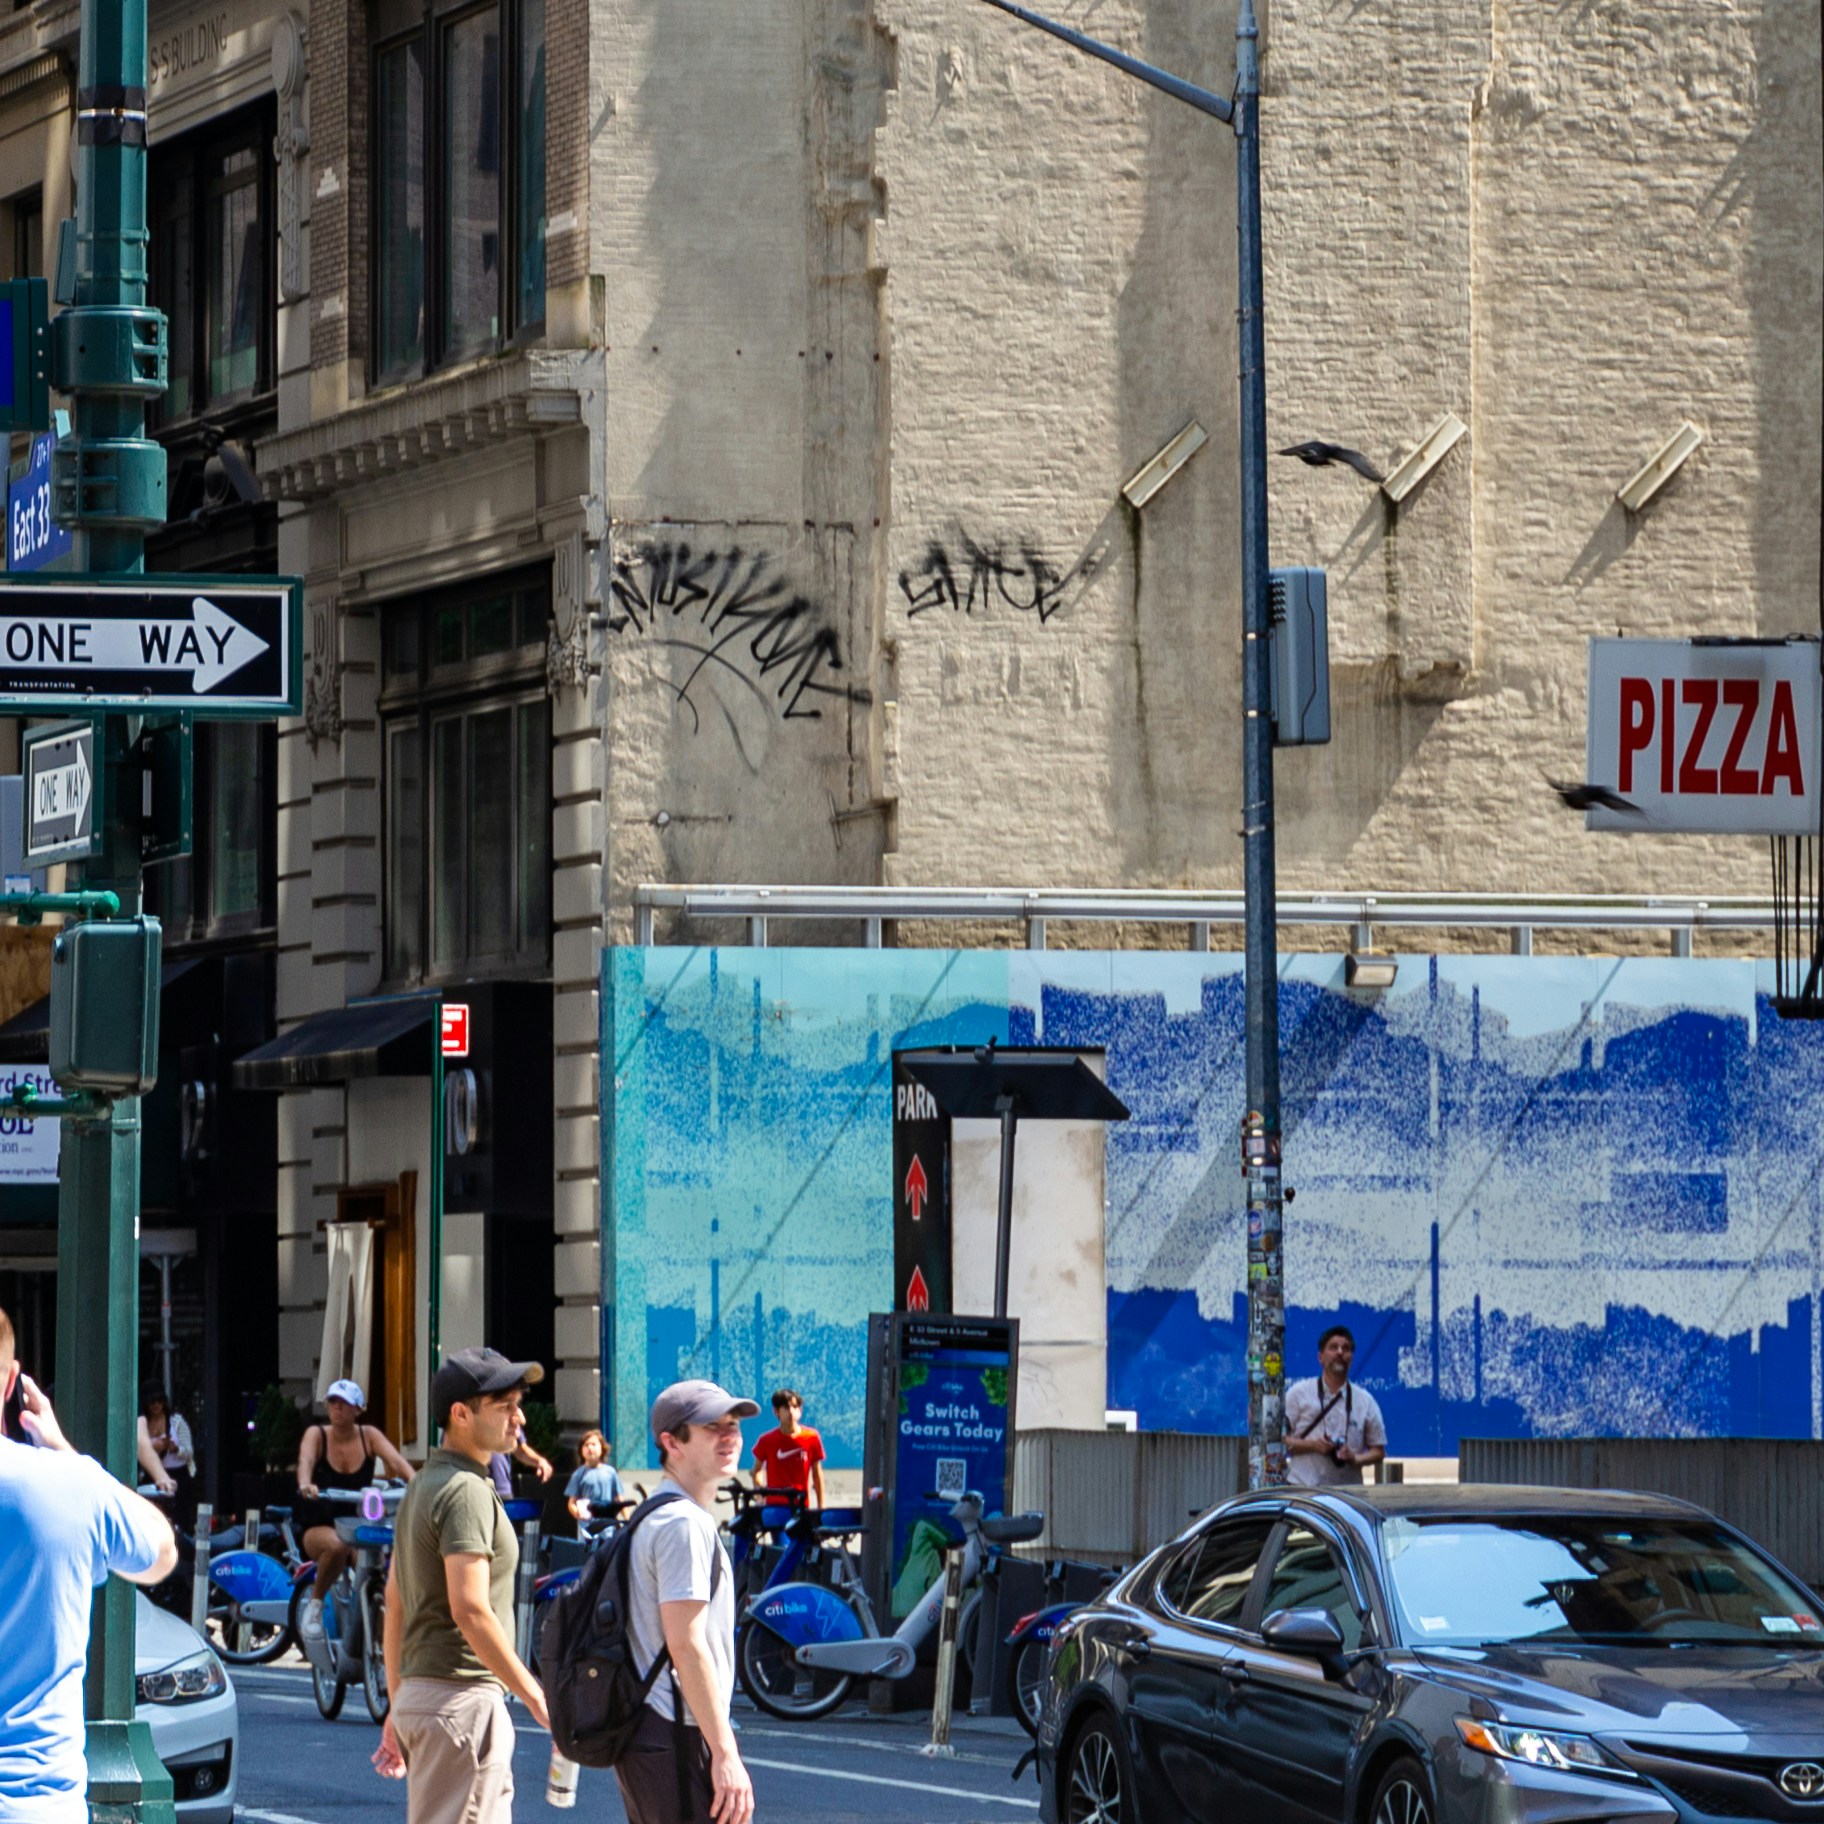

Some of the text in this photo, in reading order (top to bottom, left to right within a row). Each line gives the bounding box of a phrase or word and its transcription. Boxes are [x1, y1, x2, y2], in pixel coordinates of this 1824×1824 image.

[14, 494, 36, 562] East
[5, 622, 236, 665] ONE WAY
[9, 681, 76, 689] TRANSPORTATION
[1618, 676, 1805, 796] PIZZA
[40, 767, 86, 816] ONE WAY
[900, 1420, 1003, 1443] Gears Today
[925, 1403, 980, 1420] Switch
